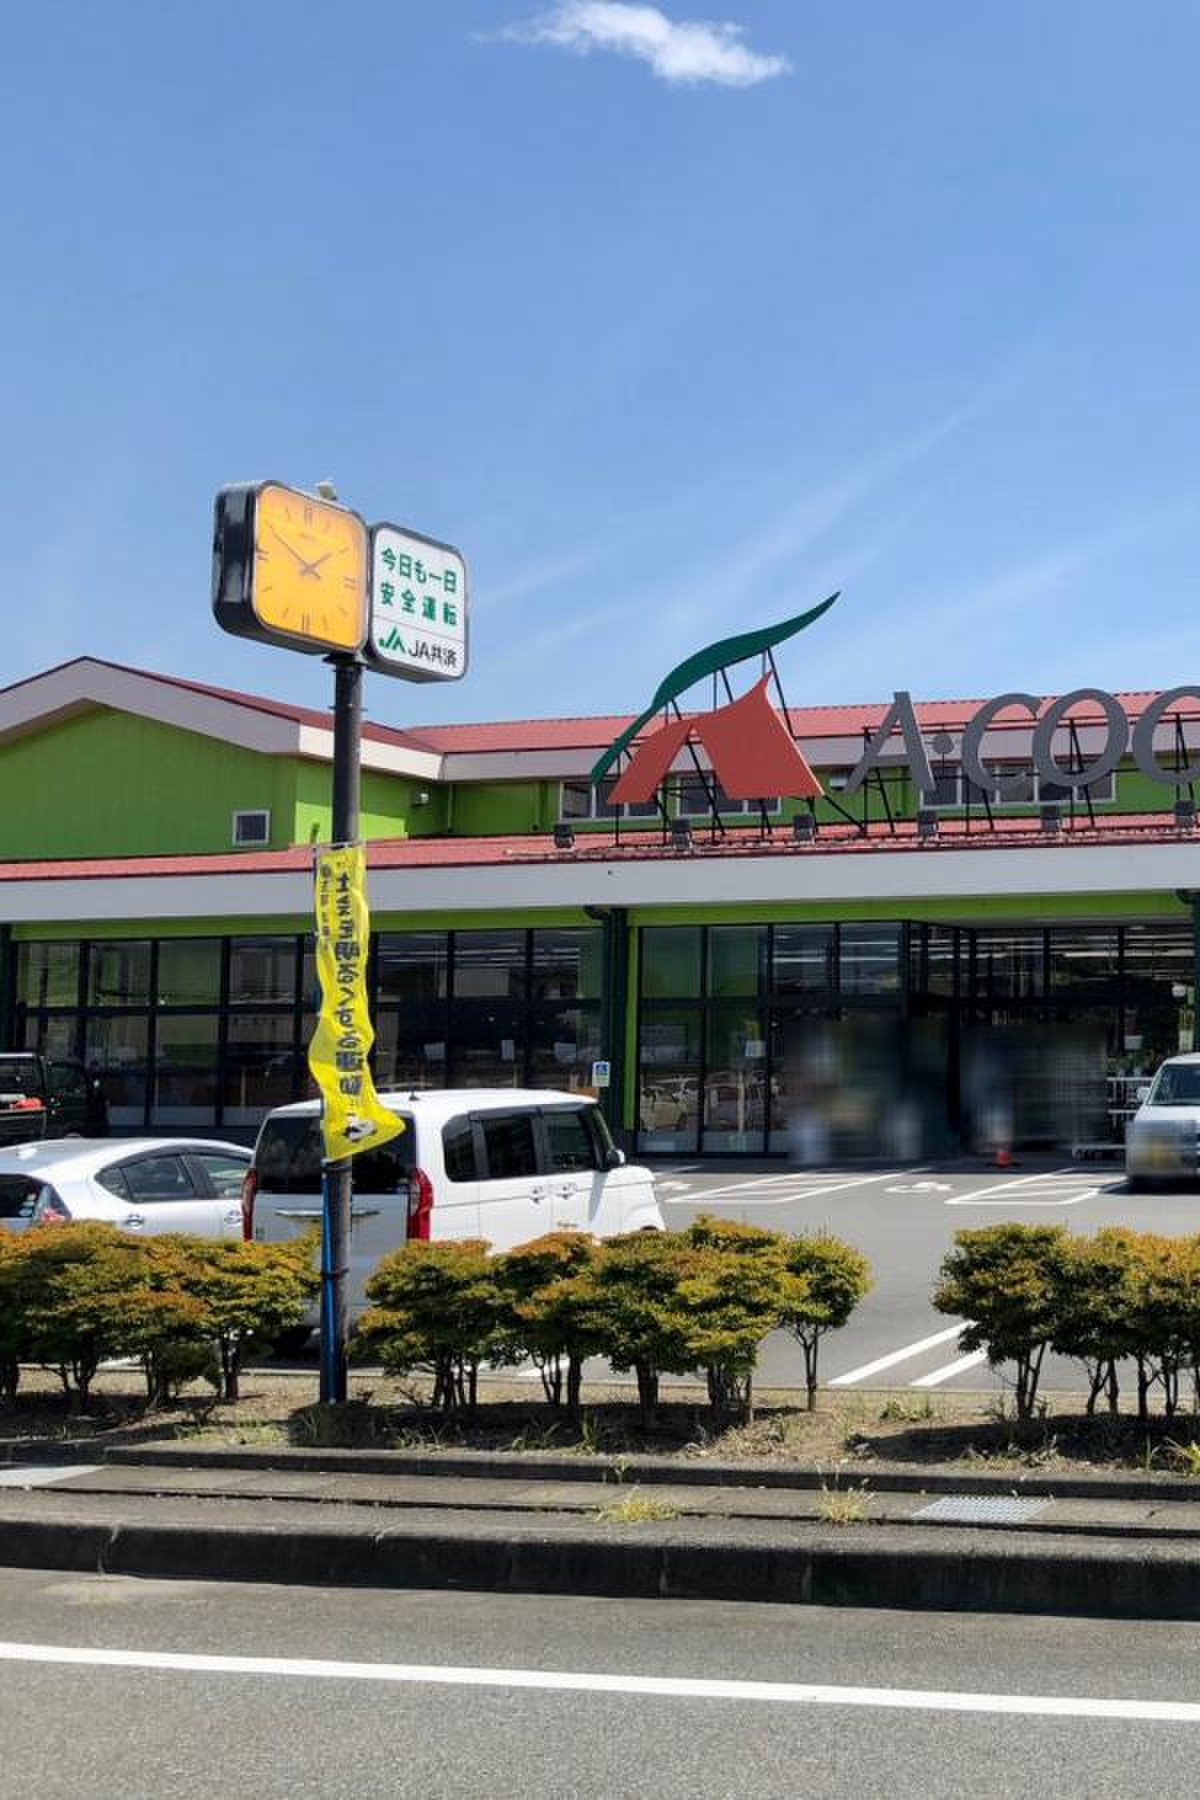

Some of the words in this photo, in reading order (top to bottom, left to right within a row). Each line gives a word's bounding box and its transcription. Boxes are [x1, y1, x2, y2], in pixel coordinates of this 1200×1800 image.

[382, 547, 457, 593] 今日も一日
[380, 582, 457, 626] 安全運転
[408, 639, 457, 667] JA共済
